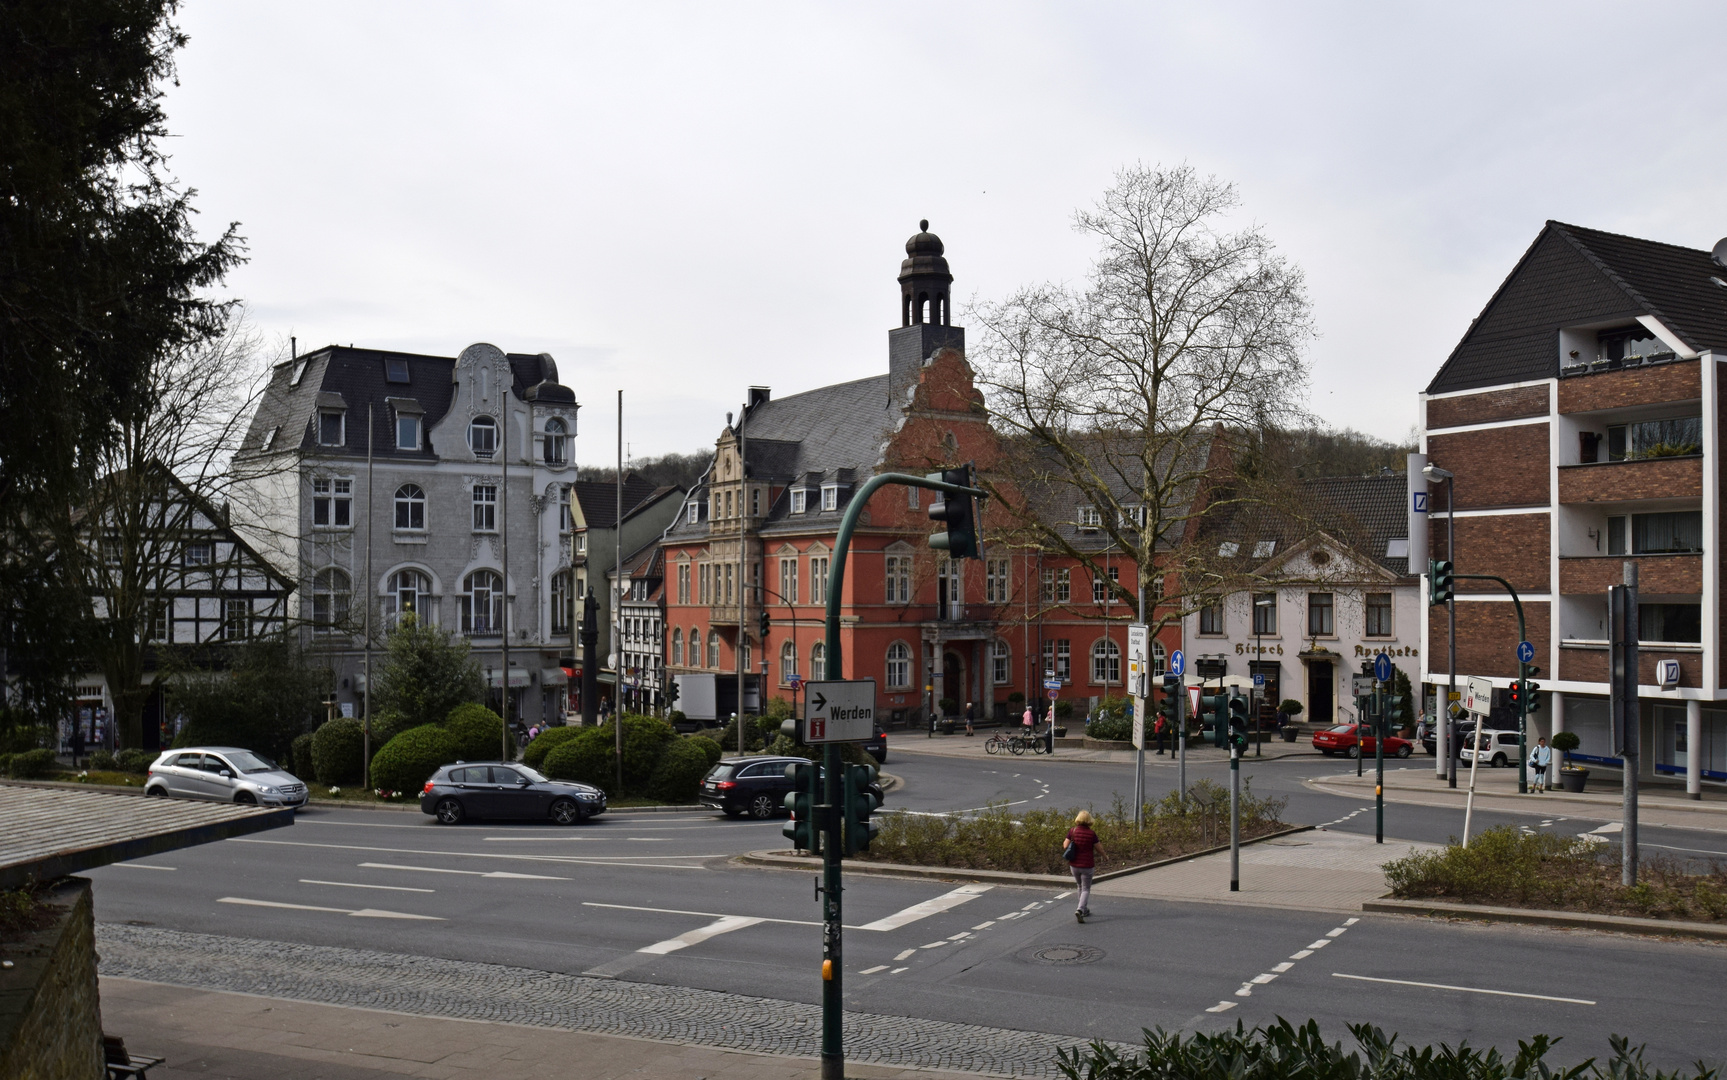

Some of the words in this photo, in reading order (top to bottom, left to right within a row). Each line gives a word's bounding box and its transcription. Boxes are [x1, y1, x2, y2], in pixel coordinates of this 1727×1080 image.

[1235, 643, 1284, 656] Hirsch
[1354, 645, 1418, 658] Apotheke
[1474, 691, 1490, 703] Werden
[830, 705, 871, 720] Werden
